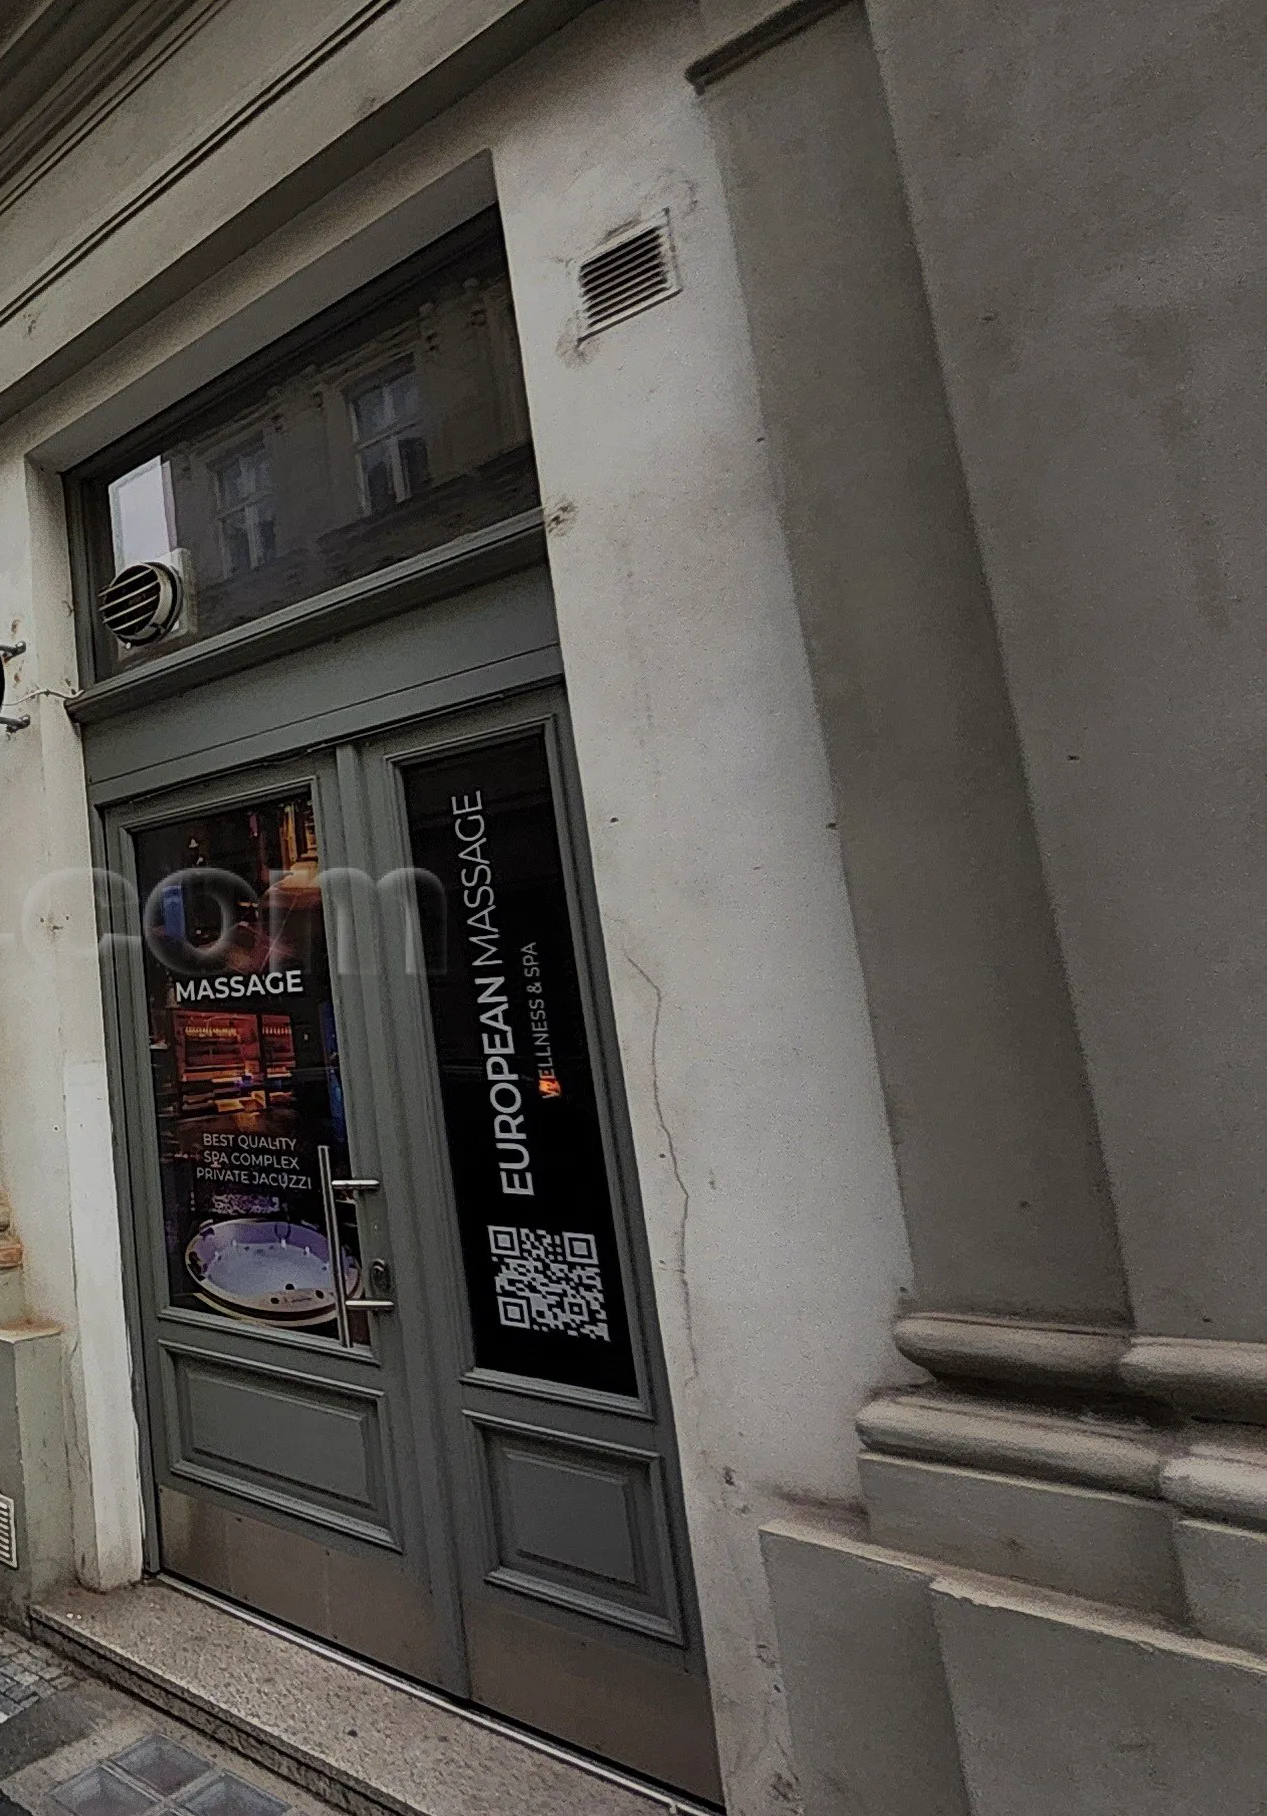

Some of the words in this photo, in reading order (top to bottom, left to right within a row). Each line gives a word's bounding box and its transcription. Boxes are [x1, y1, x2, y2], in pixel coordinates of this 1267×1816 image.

[451, 790, 503, 966] MASSAGE
[520, 942, 541, 978] SPA
[175, 970, 303, 1002] MASSAGE
[526, 981, 543, 994] &
[530, 998, 562, 1100] WELLNESS
[474, 975, 534, 1196] EUROPEAN
[202, 1132, 235, 1147] BEST
[237, 1134, 296, 1151] QUALITY
[203, 1150, 229, 1164] SPA
[231, 1152, 300, 1171] COMPLEX
[196, 1167, 250, 1184] PRIVATE
[252, 1171, 312, 1190] JACUZZI
